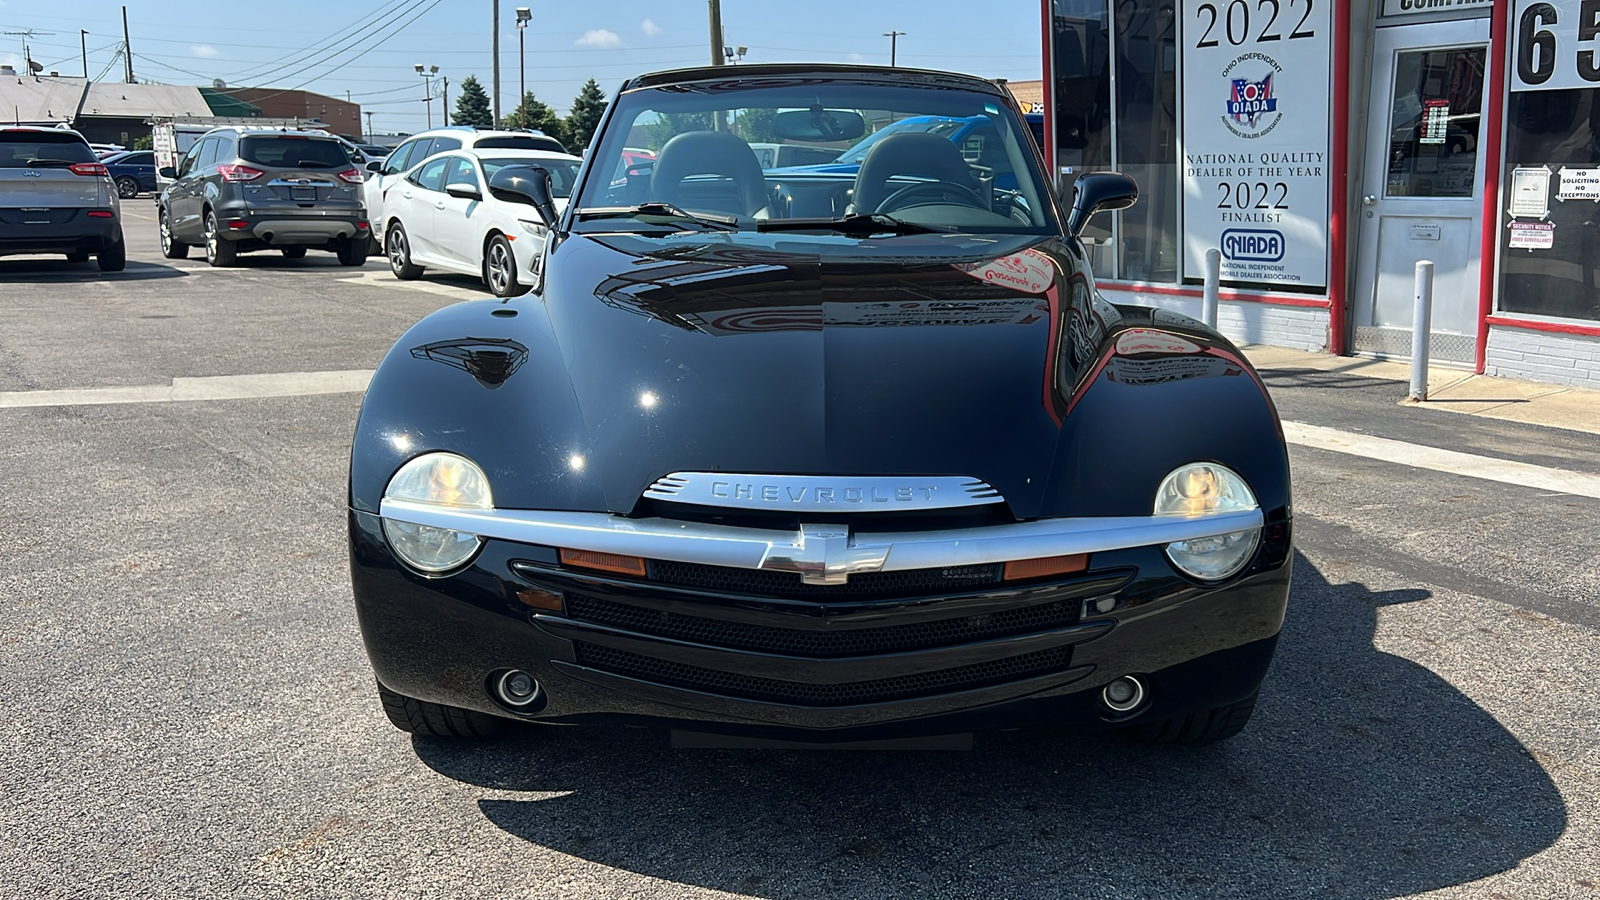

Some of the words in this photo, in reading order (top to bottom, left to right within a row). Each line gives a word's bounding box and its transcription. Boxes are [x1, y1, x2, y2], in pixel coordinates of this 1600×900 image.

[1196, 0, 1315, 48] 2022
[1222, 60, 1237, 77] OHIO
[1237, 52, 1283, 73] INDEPENDENT
[1232, 100, 1268, 113] OIADA
[1221, 115, 1241, 137] AUTOMOBILE
[1260, 112, 1283, 137] ASSOCIATION
[1186, 153, 1254, 165] NATIONAL
[1260, 152, 1324, 165] QUALITY
[1187, 167, 1233, 177] DEALER
[1237, 167, 1253, 177] OF
[1258, 167, 1282, 177] THE
[1288, 166, 1322, 177] YEAR
[1217, 181, 1289, 210] 2022
[1221, 212, 1282, 223] FINALIST
[1225, 235, 1279, 257] NIADA
[1221, 262, 1247, 270] NATIONAL
[1248, 263, 1285, 271] INDEPENDENT
[1220, 270, 1239, 278] MOBILE
[1240, 271, 1263, 279] DEALERS
[1263, 273, 1301, 281] ASSOCIATION
[710, 480, 938, 504] CHEVROLET
